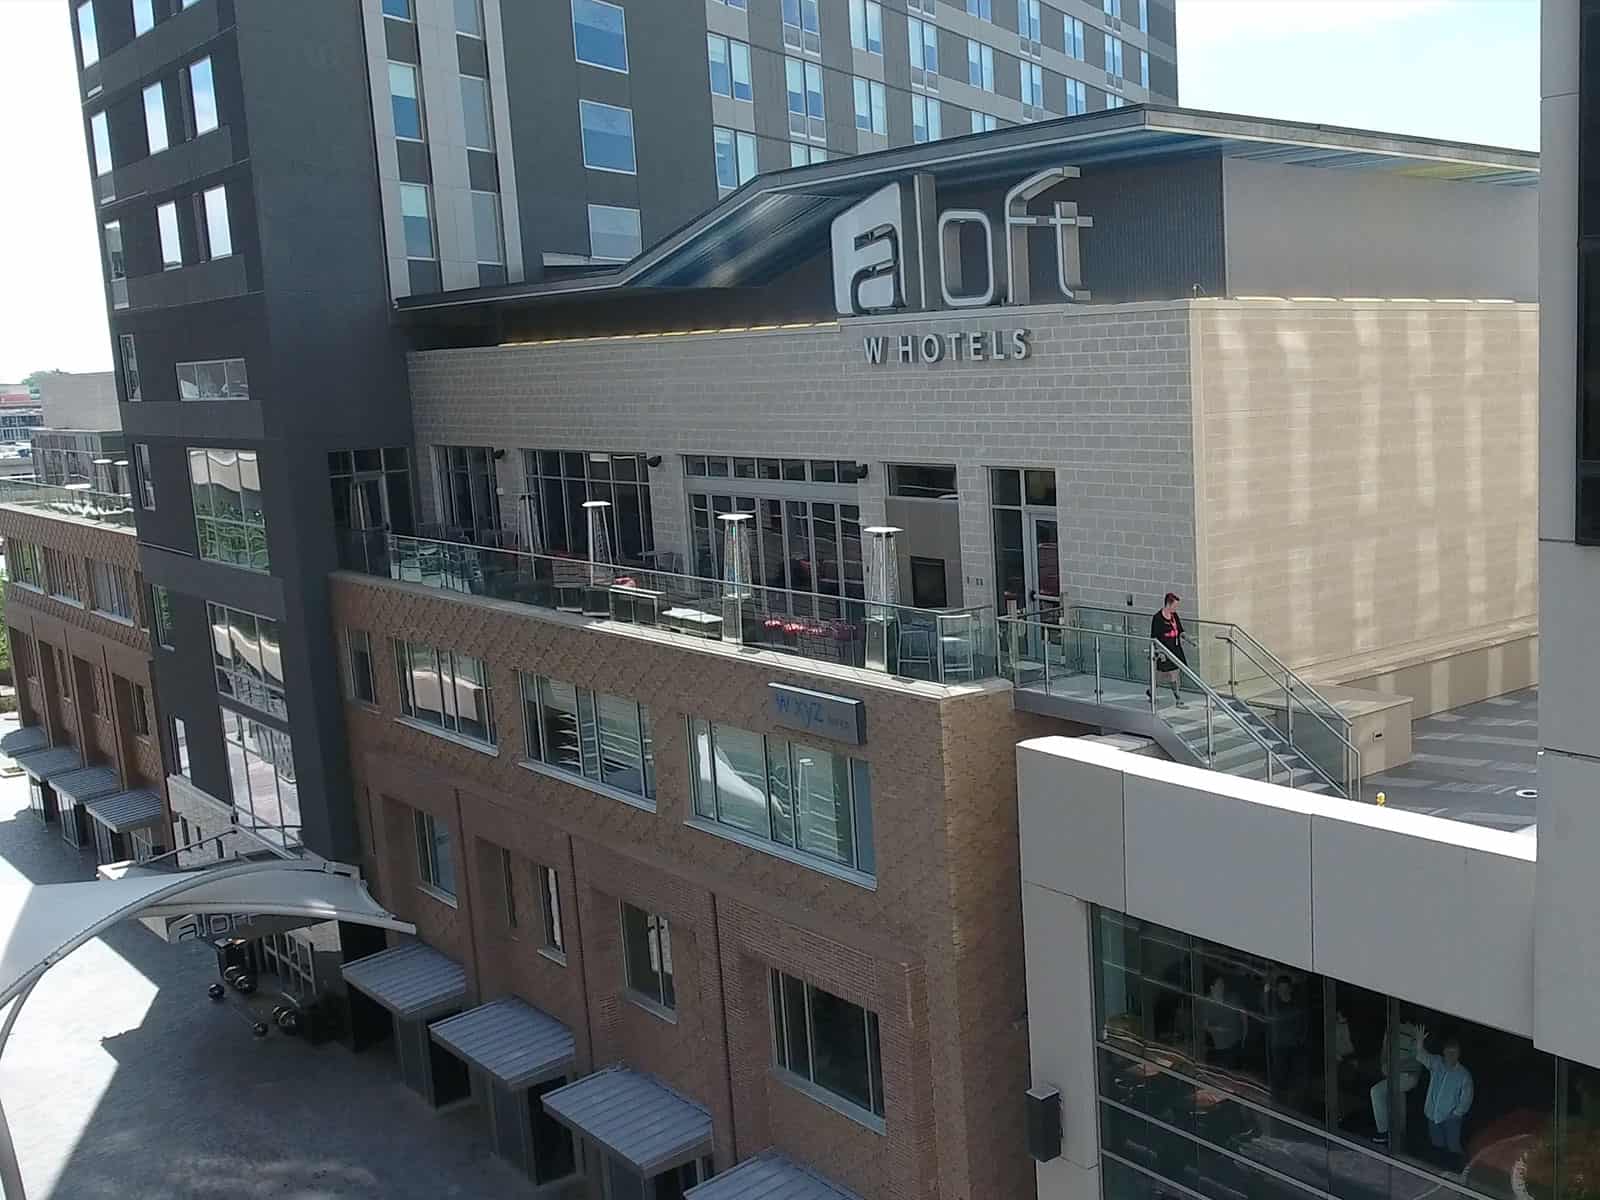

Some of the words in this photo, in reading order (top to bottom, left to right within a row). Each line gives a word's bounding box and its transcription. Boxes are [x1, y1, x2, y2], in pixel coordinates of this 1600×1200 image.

[831, 166, 1093, 314] aloft
[863, 336, 887, 364] W
[899, 328, 1031, 364] HOTELS
